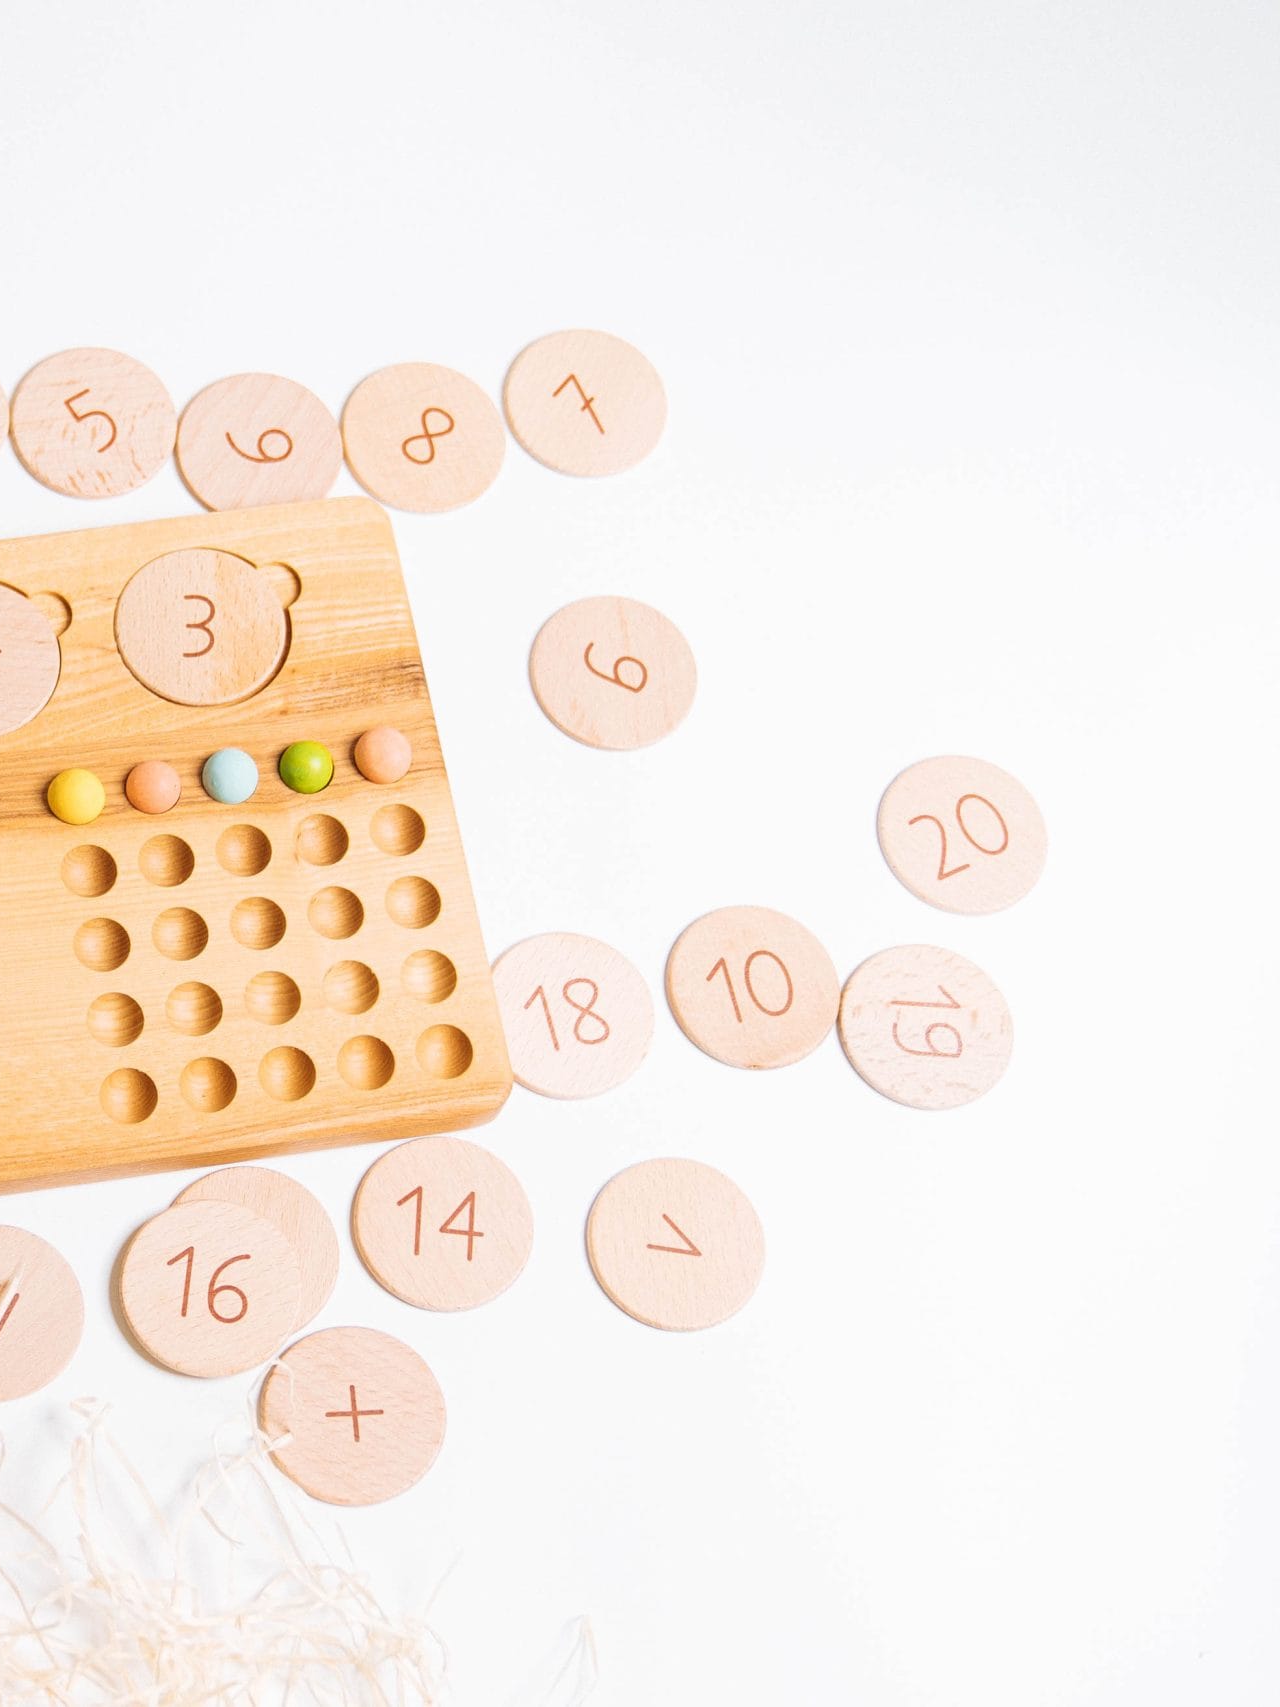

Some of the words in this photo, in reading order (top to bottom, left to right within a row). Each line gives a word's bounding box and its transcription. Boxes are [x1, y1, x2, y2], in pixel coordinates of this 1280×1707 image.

[63, 388, 118, 454] 5
[401, 406, 455, 466] 8
[551, 373, 606, 436] 7
[182, 594, 216, 659] 3
[907, 793, 1009, 881] 20
[523, 977, 610, 1052] 18
[705, 949, 794, 1024] 10
[889, 985, 963, 1059] 19
[395, 1185, 485, 1262] 14
[166, 1245, 252, 1325] 16
